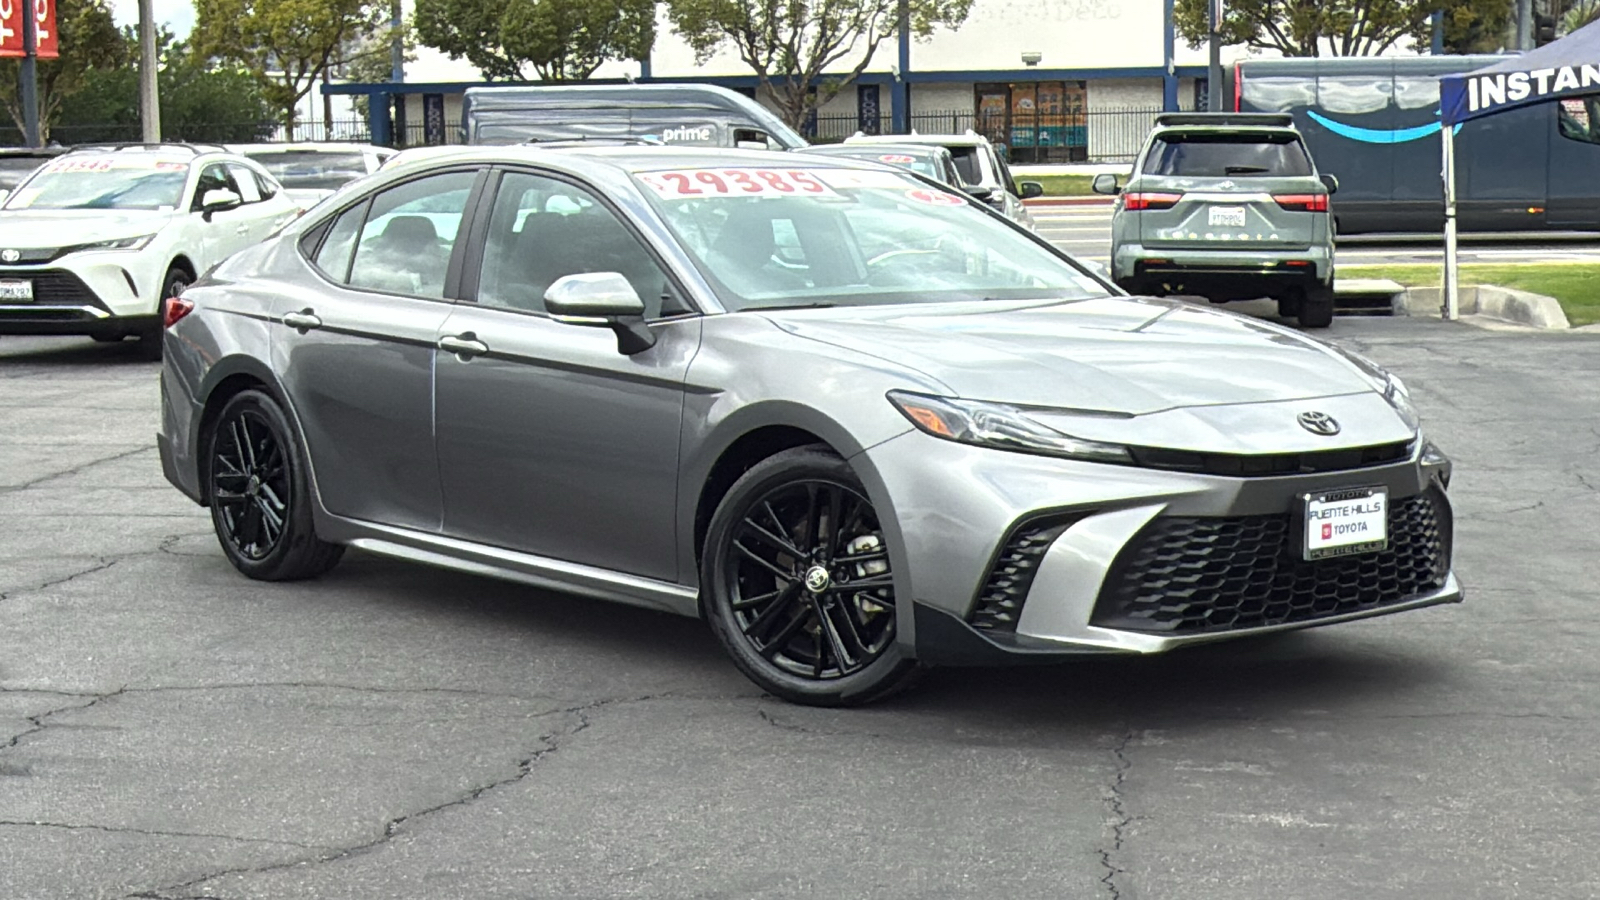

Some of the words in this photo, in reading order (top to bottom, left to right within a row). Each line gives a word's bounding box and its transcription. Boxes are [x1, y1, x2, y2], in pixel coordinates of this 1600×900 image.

[663, 125, 710, 142] prime
[1309, 506, 1349, 520] PUENTE
[1351, 502, 1381, 515] HILLS
[1333, 521, 1368, 535] TOYOTA
